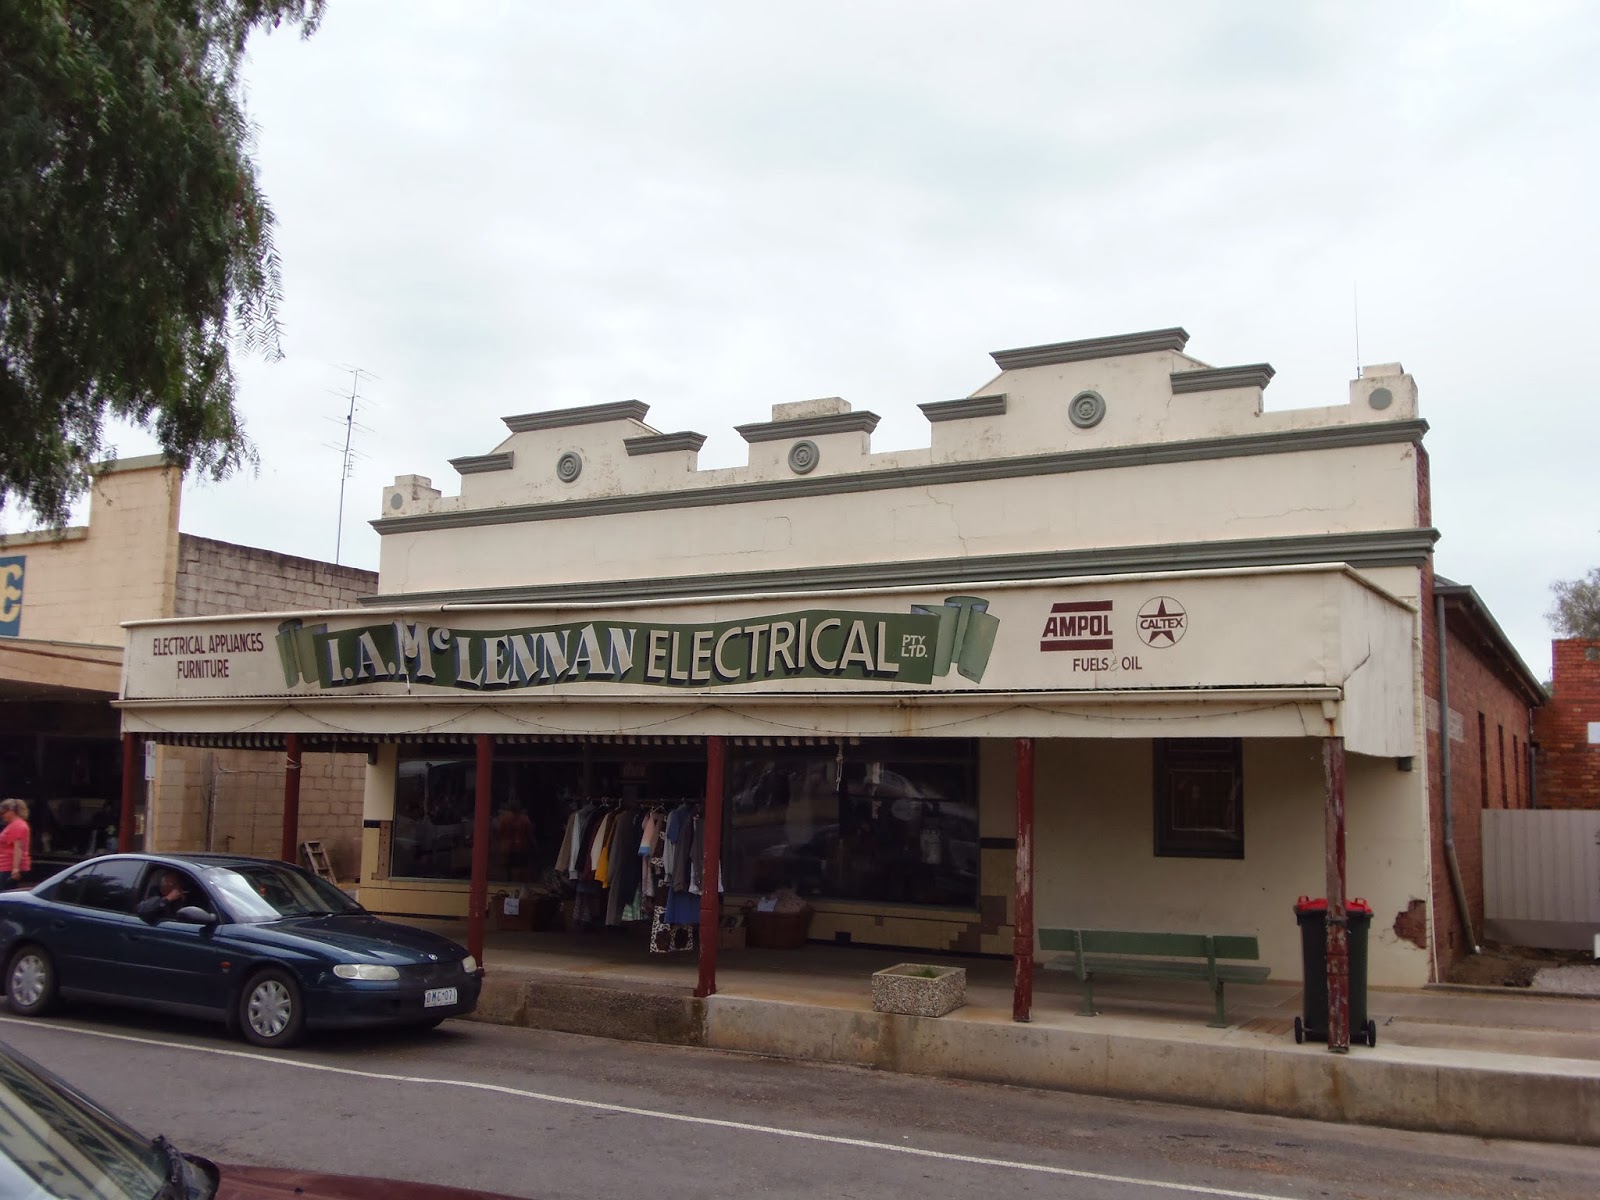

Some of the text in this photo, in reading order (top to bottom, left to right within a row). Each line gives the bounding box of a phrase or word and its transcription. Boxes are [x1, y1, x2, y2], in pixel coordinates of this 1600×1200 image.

[1042, 615, 1113, 638] AMPOL
[1140, 617, 1184, 630] CALTEX
[153, 632, 264, 656] ELECTRICAL APPLIANCES
[647, 617, 900, 680] ELECTRICAL
[902, 634, 926, 647] PTY
[901, 644, 928, 658] LTD.
[177, 658, 230, 679] FURNITURE
[1073, 657, 1109, 672] FUELS
[1121, 656, 1142, 671] OIL
